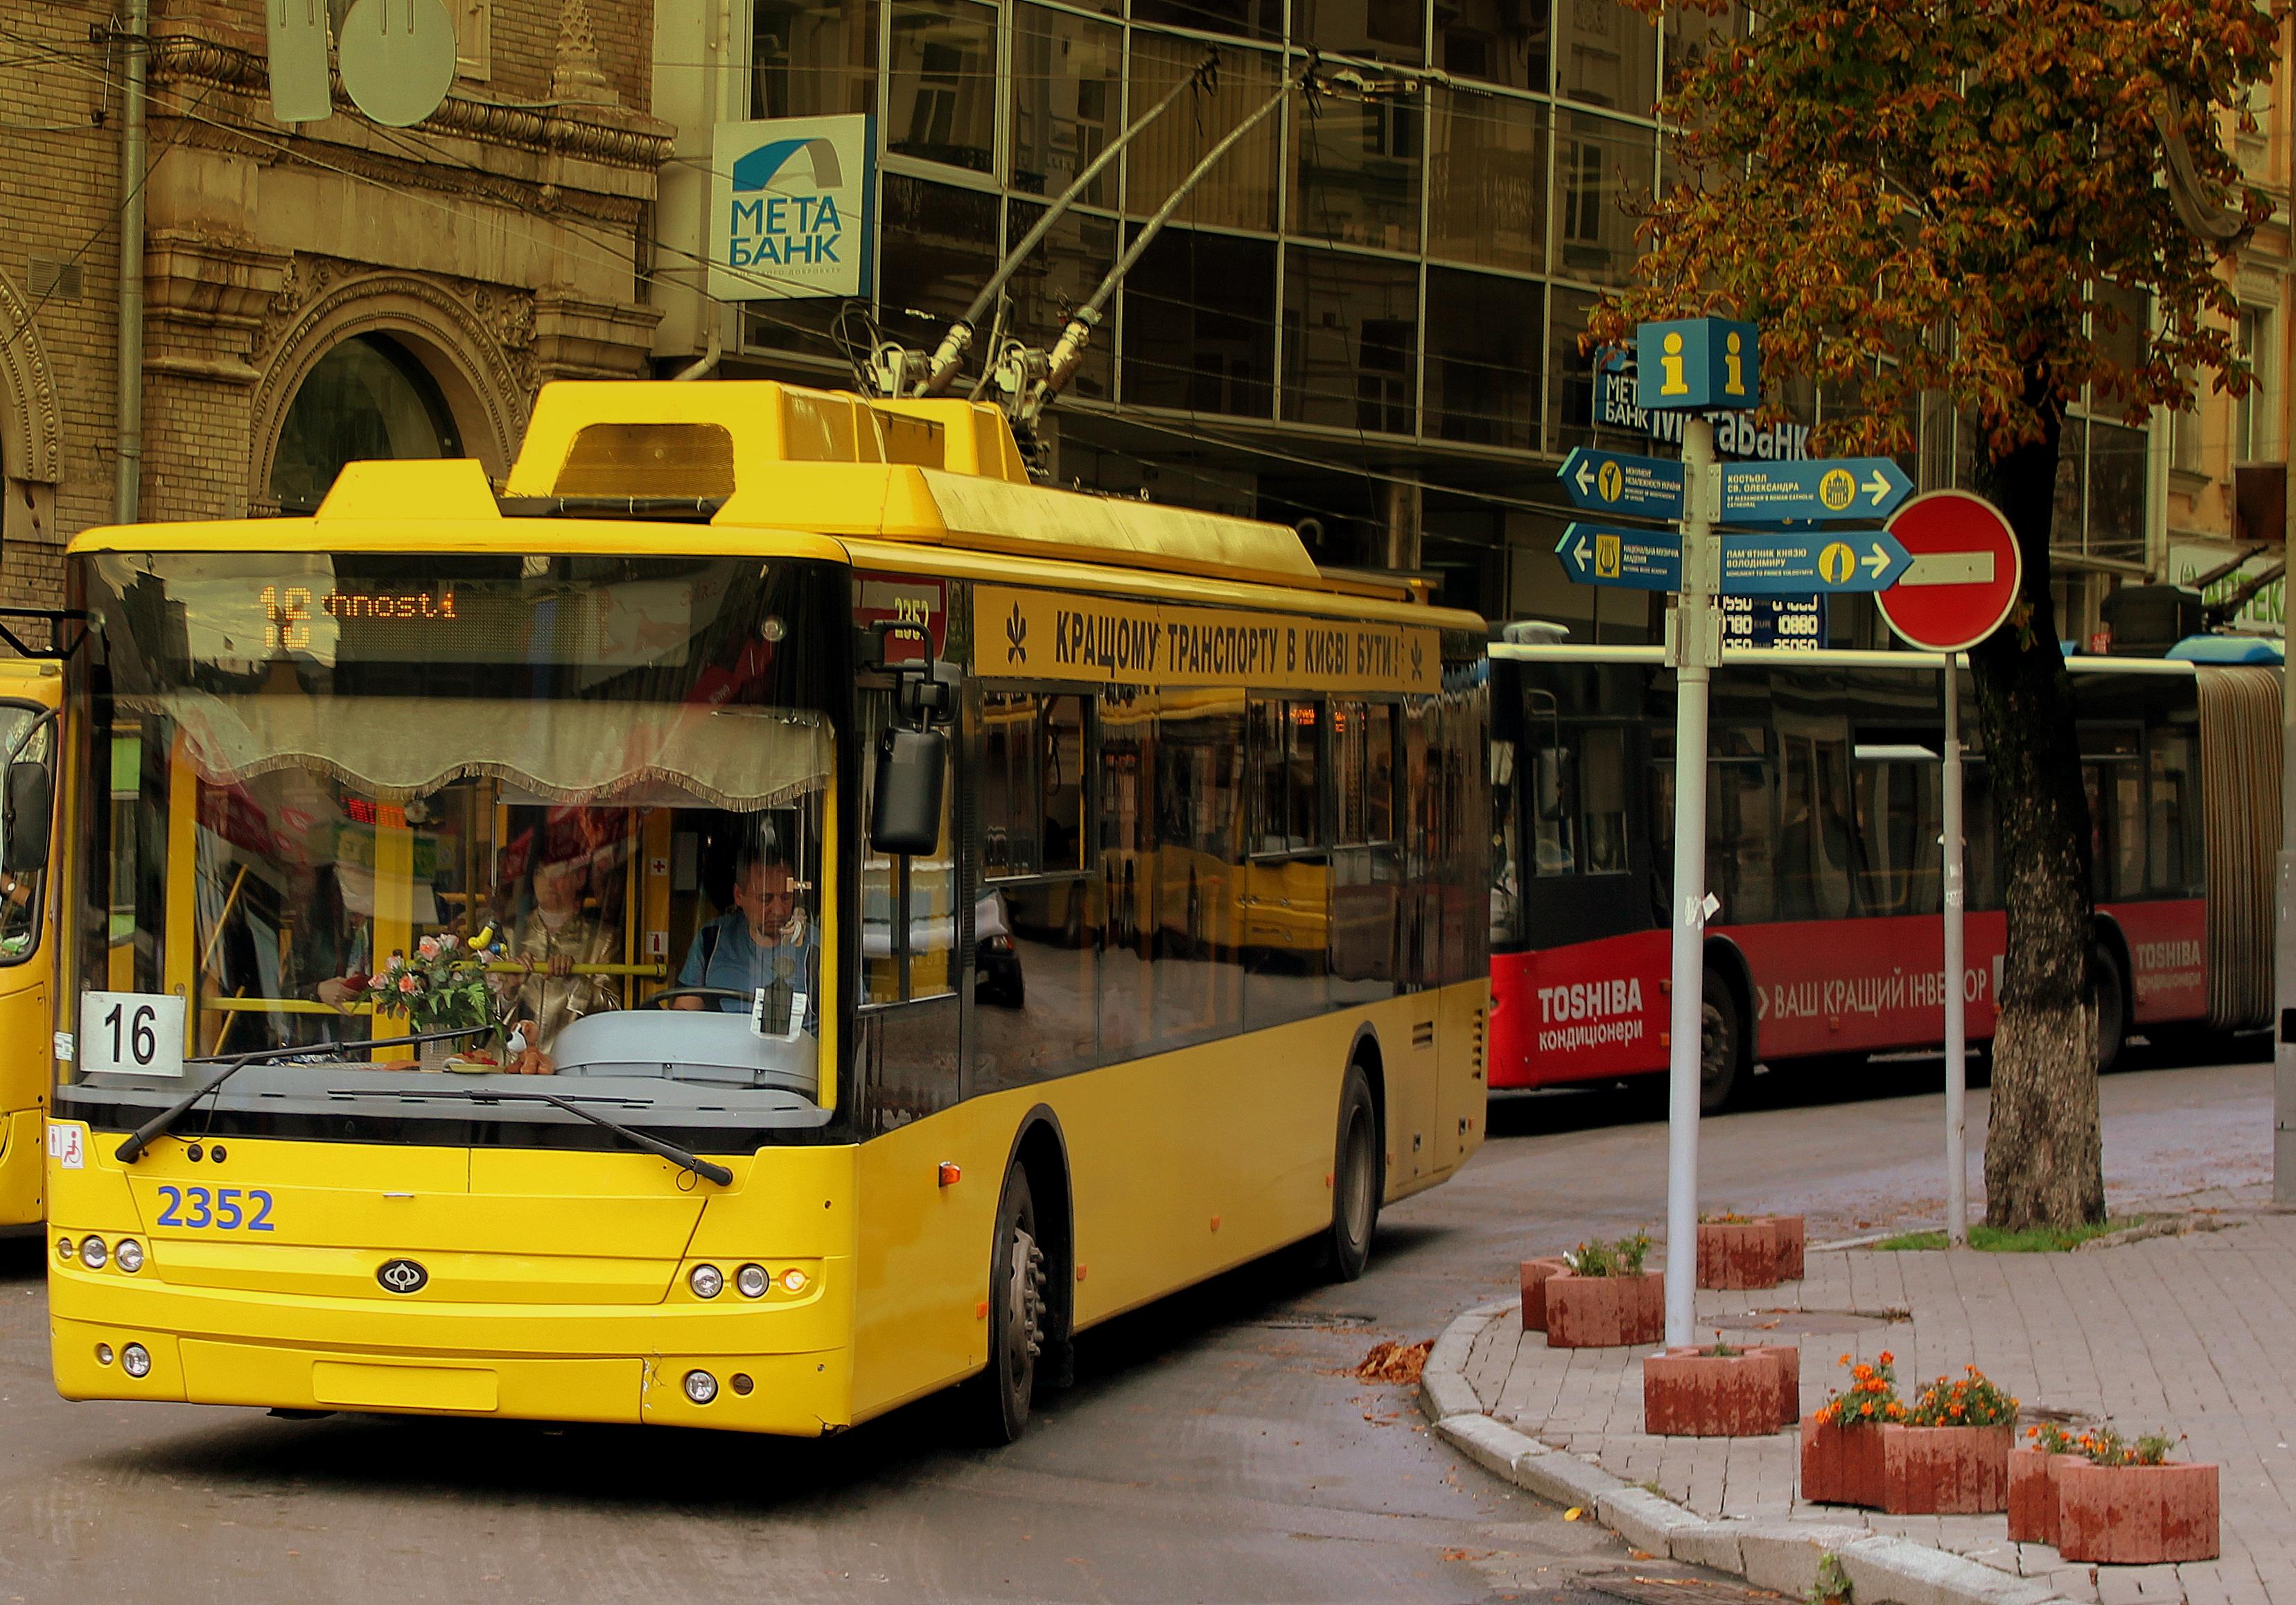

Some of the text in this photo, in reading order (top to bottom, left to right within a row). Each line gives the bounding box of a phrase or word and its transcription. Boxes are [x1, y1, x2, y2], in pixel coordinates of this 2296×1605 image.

[731, 195, 841, 236] МЕТА
[730, 234, 841, 266] БАНК
[1606, 373, 1638, 406] МЕТ
[1605, 400, 1649, 430] БАНК
[1744, 482, 1799, 493] ОЛЕКСАНДРА
[1727, 559, 1786, 568] ВОЛОДИМИРУ
[1776, 548, 1807, 558] КНЯЗЮ
[1055, 610, 1160, 679] КРАЩОМУ
[1167, 624, 1278, 674] ТРАНСПОРТУ
[1287, 628, 1296, 672] В
[1305, 629, 1348, 674] КИЄВІ
[2136, 940, 2200, 969] TOSHIBA
[1538, 977, 1643, 1023] TOSHIBA
[1774, 967, 1987, 1019] ВАШ КРАЩИЙ ІНВЕОР
[105, 1003, 155, 1064] 16
[1539, 1017, 1643, 1052] кондиціонери
[157, 1186, 274, 1231] 2352
